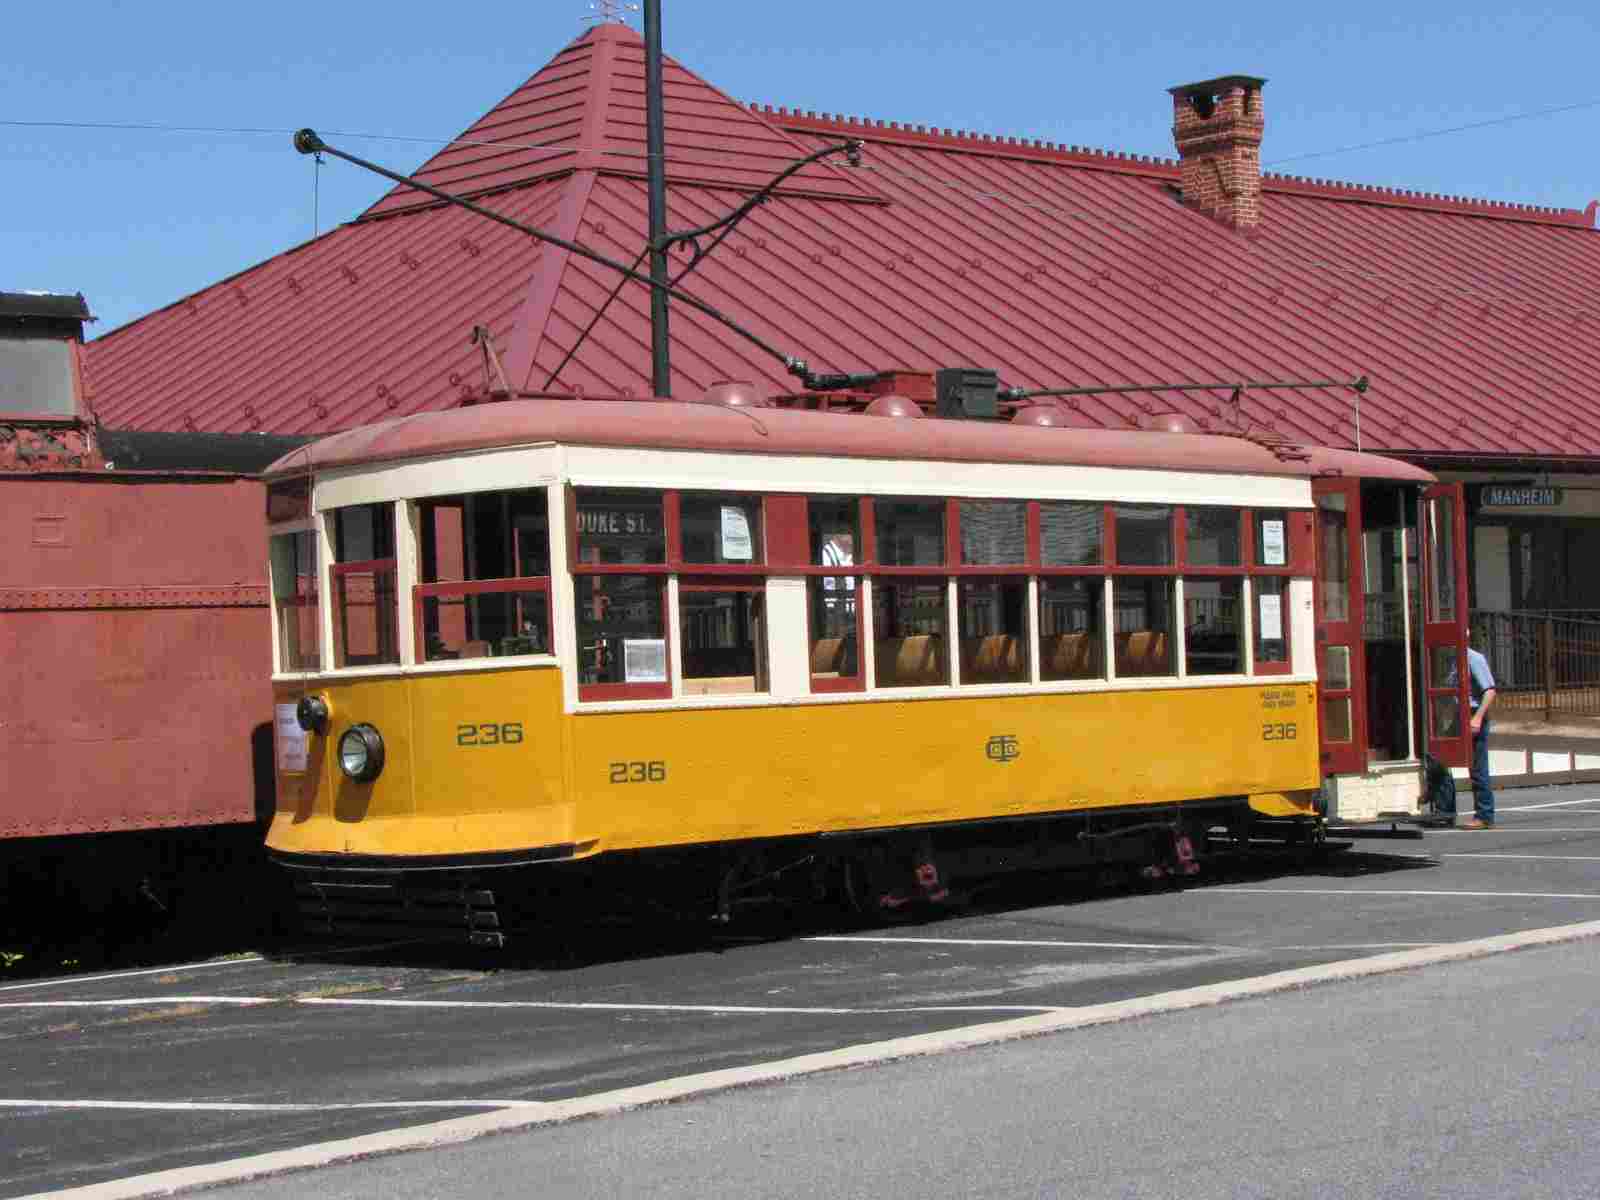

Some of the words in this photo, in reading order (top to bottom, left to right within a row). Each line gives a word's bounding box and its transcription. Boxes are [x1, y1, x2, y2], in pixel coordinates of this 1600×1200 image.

[1490, 488, 1555, 505] MANHEIM
[576, 511, 620, 534] DUKE
[456, 722, 524, 746] 236
[1262, 722, 1297, 741] 236
[608, 760, 666, 784] 236
